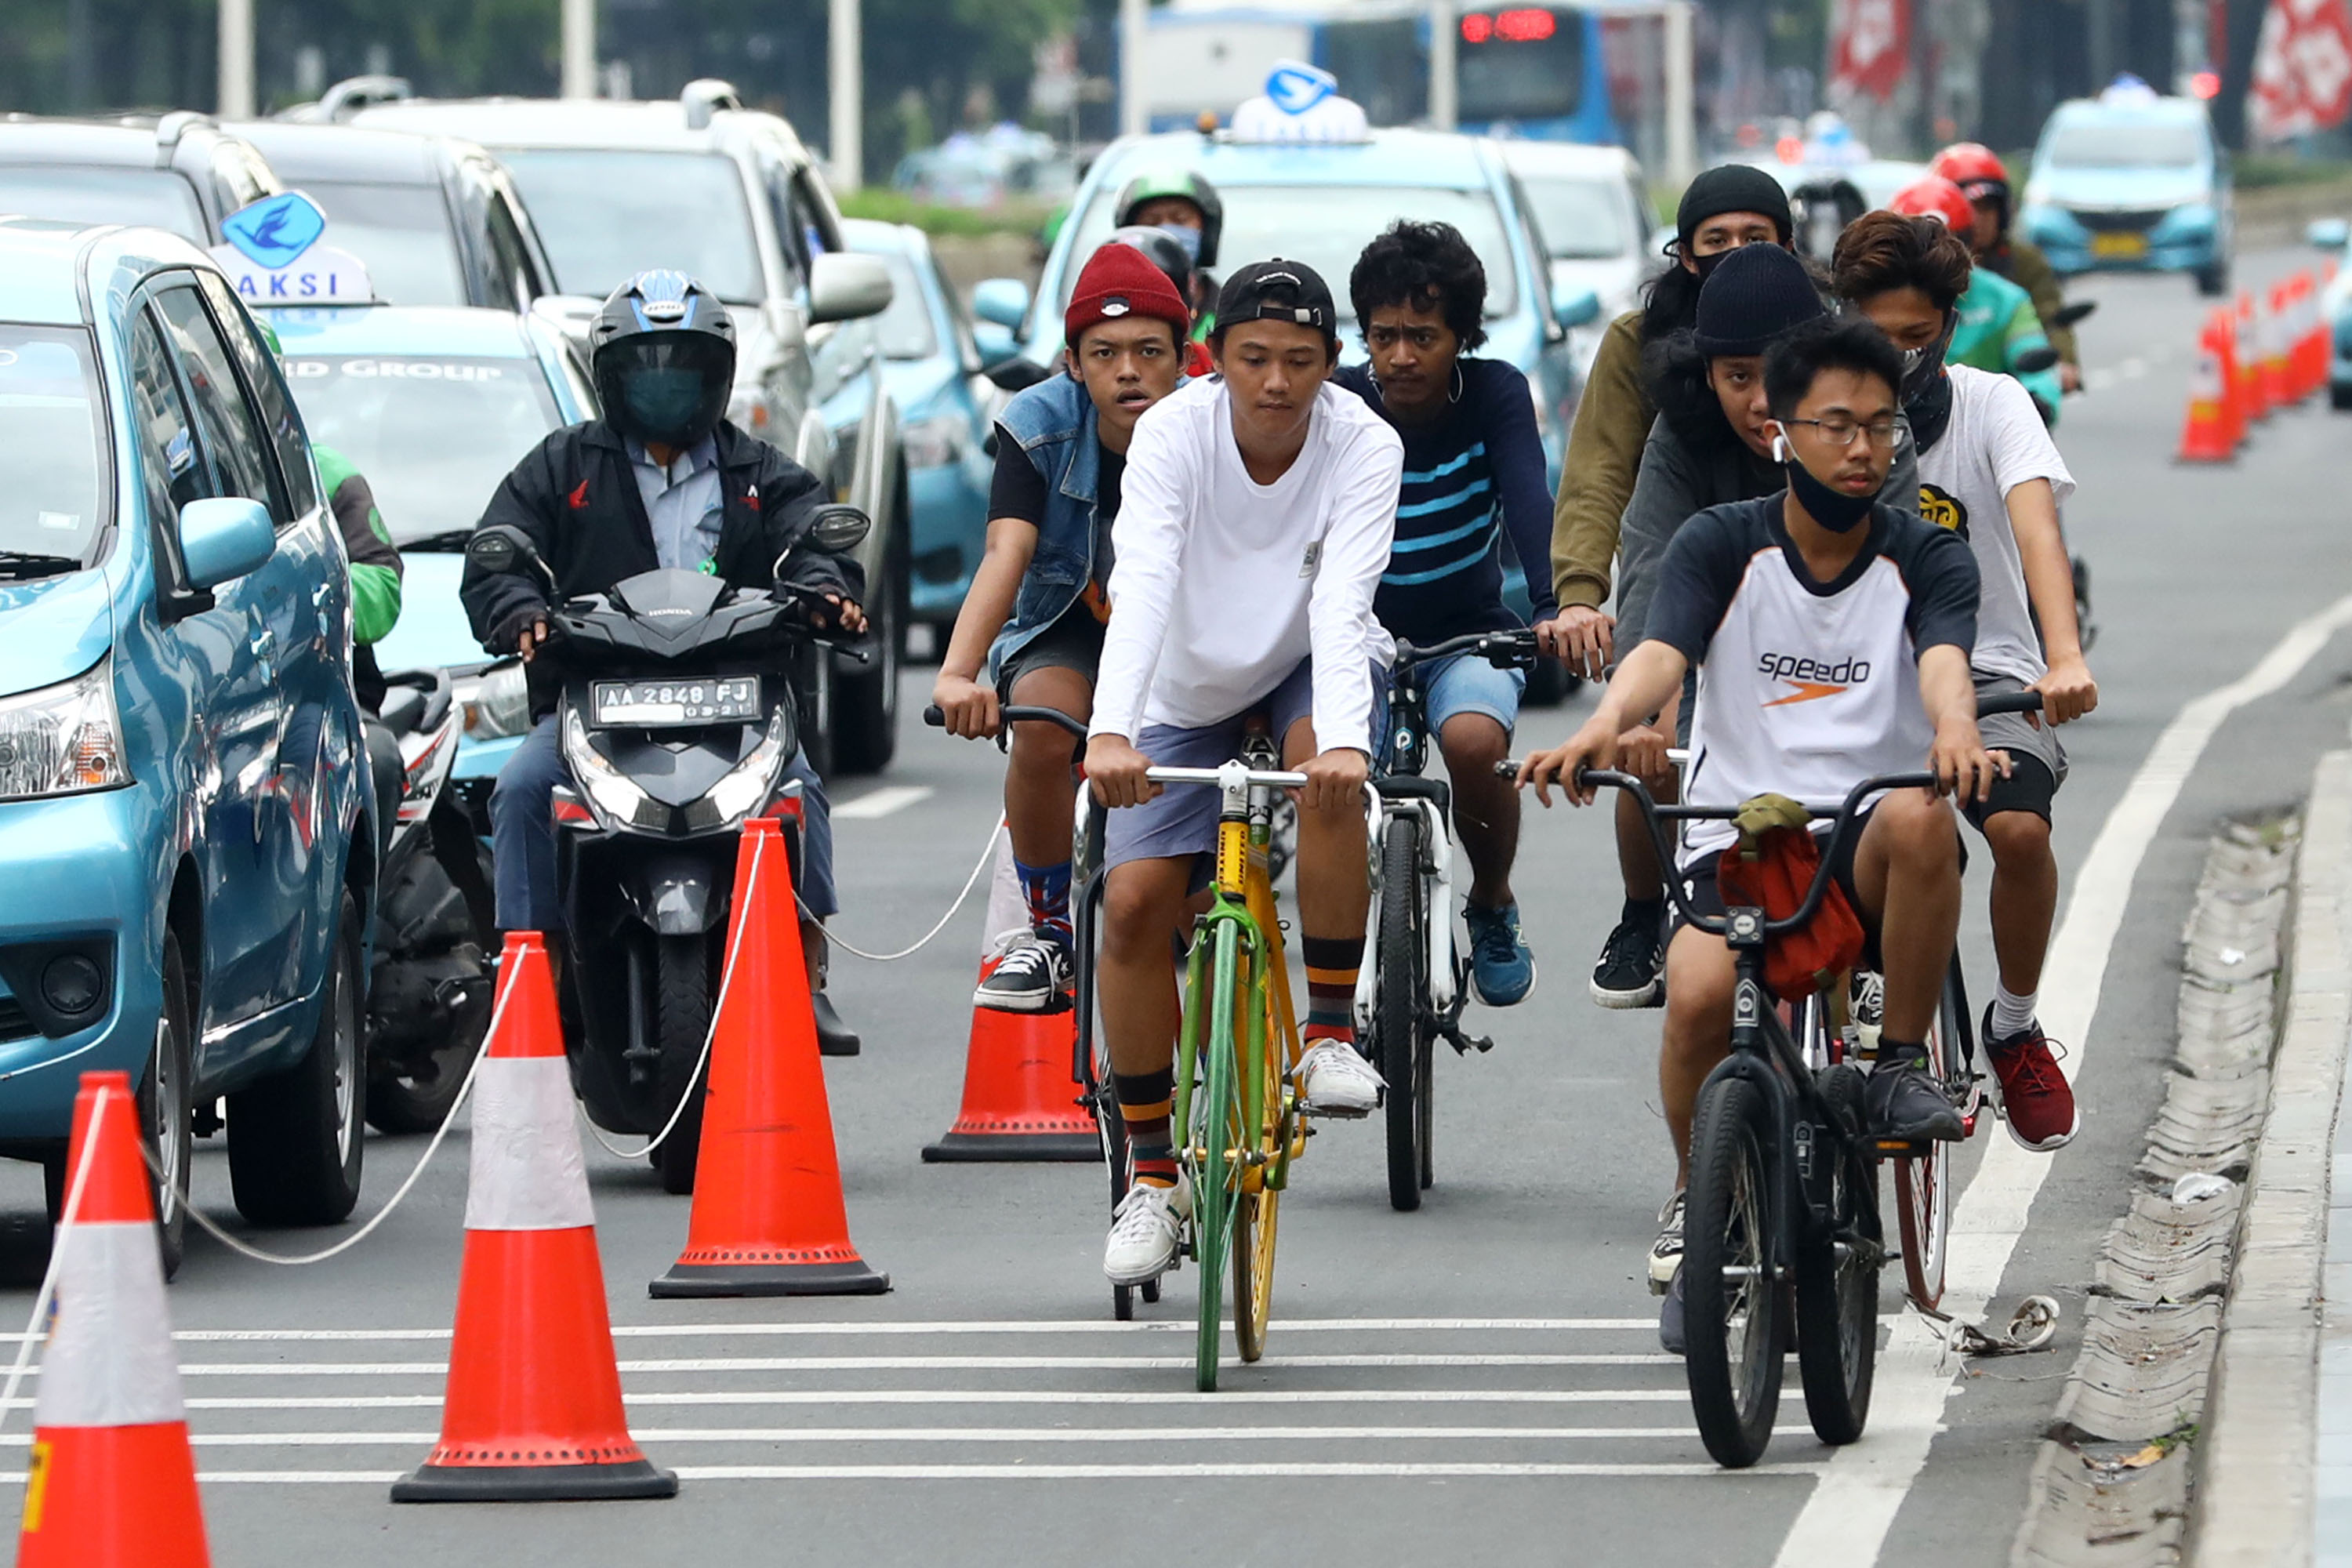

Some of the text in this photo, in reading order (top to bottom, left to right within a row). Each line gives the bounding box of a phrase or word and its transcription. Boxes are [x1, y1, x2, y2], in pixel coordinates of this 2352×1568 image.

[1758, 652, 1871, 684] speedo
[605, 684, 749, 706] AA 2848 FJ
